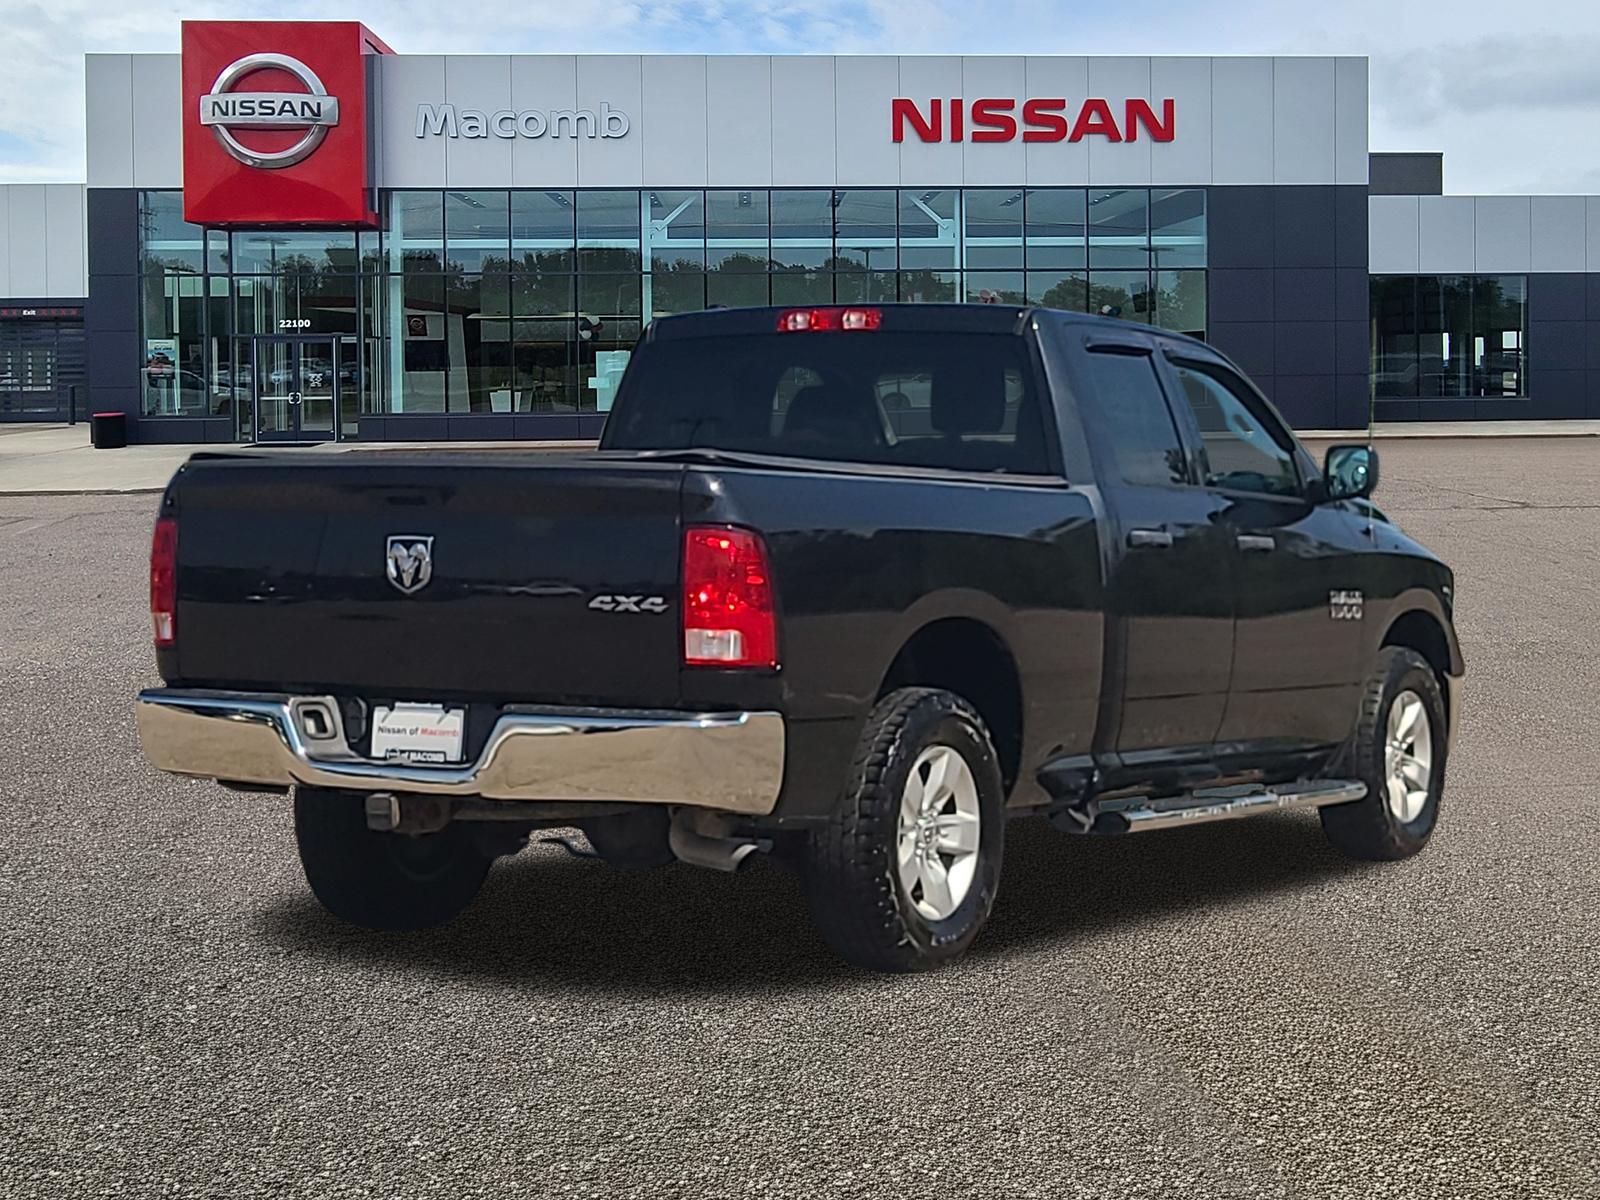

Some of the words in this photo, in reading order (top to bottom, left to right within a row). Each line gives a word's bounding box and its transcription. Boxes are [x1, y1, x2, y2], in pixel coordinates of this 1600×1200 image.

[211, 100, 322, 118] NISSAN
[415, 101, 631, 139] Macomb
[891, 98, 1176, 143] NISSAN
[279, 319, 311, 328] 22100
[377, 725, 407, 736] Nissan
[409, 726, 419, 736] of
[420, 727, 459, 738] Macomb
